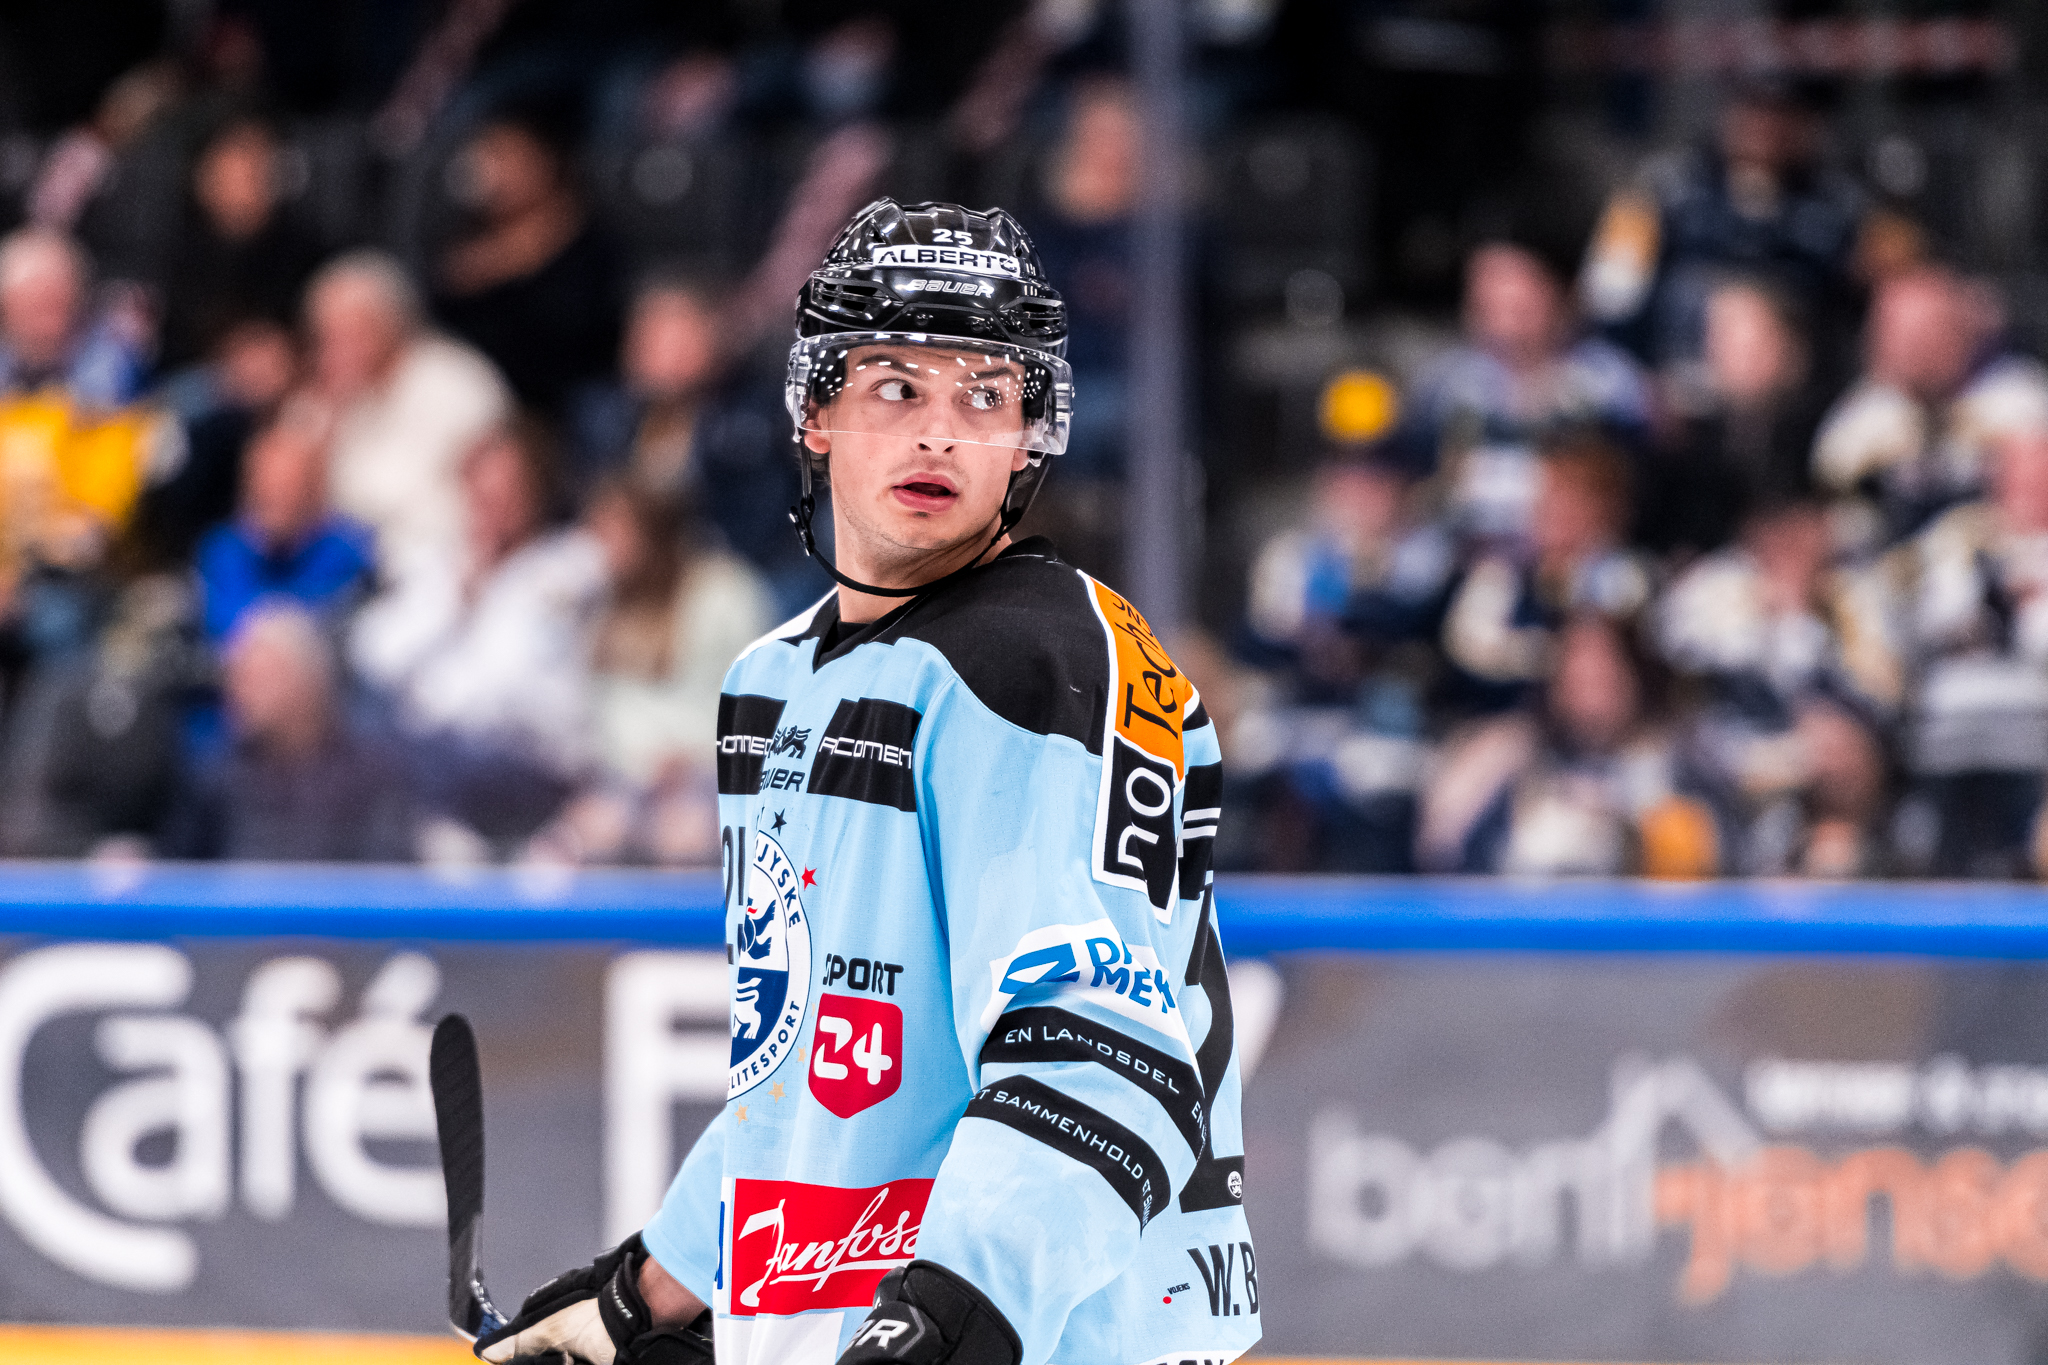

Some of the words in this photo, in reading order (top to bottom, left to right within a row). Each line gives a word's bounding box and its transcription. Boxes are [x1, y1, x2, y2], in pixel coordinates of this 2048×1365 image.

[933, 228, 974, 246] 25
[755, 839, 801, 928] JYSKE
[731, 1000, 800, 1090] LITESPORT
[814, 1015, 893, 1085] 24
[1005, 1026, 1032, 1043] EN
[1043, 1025, 1180, 1094] LANDSDEL
[0, 942, 447, 1293] Café
[993, 1090, 1144, 1180] SAMMENHOLD
